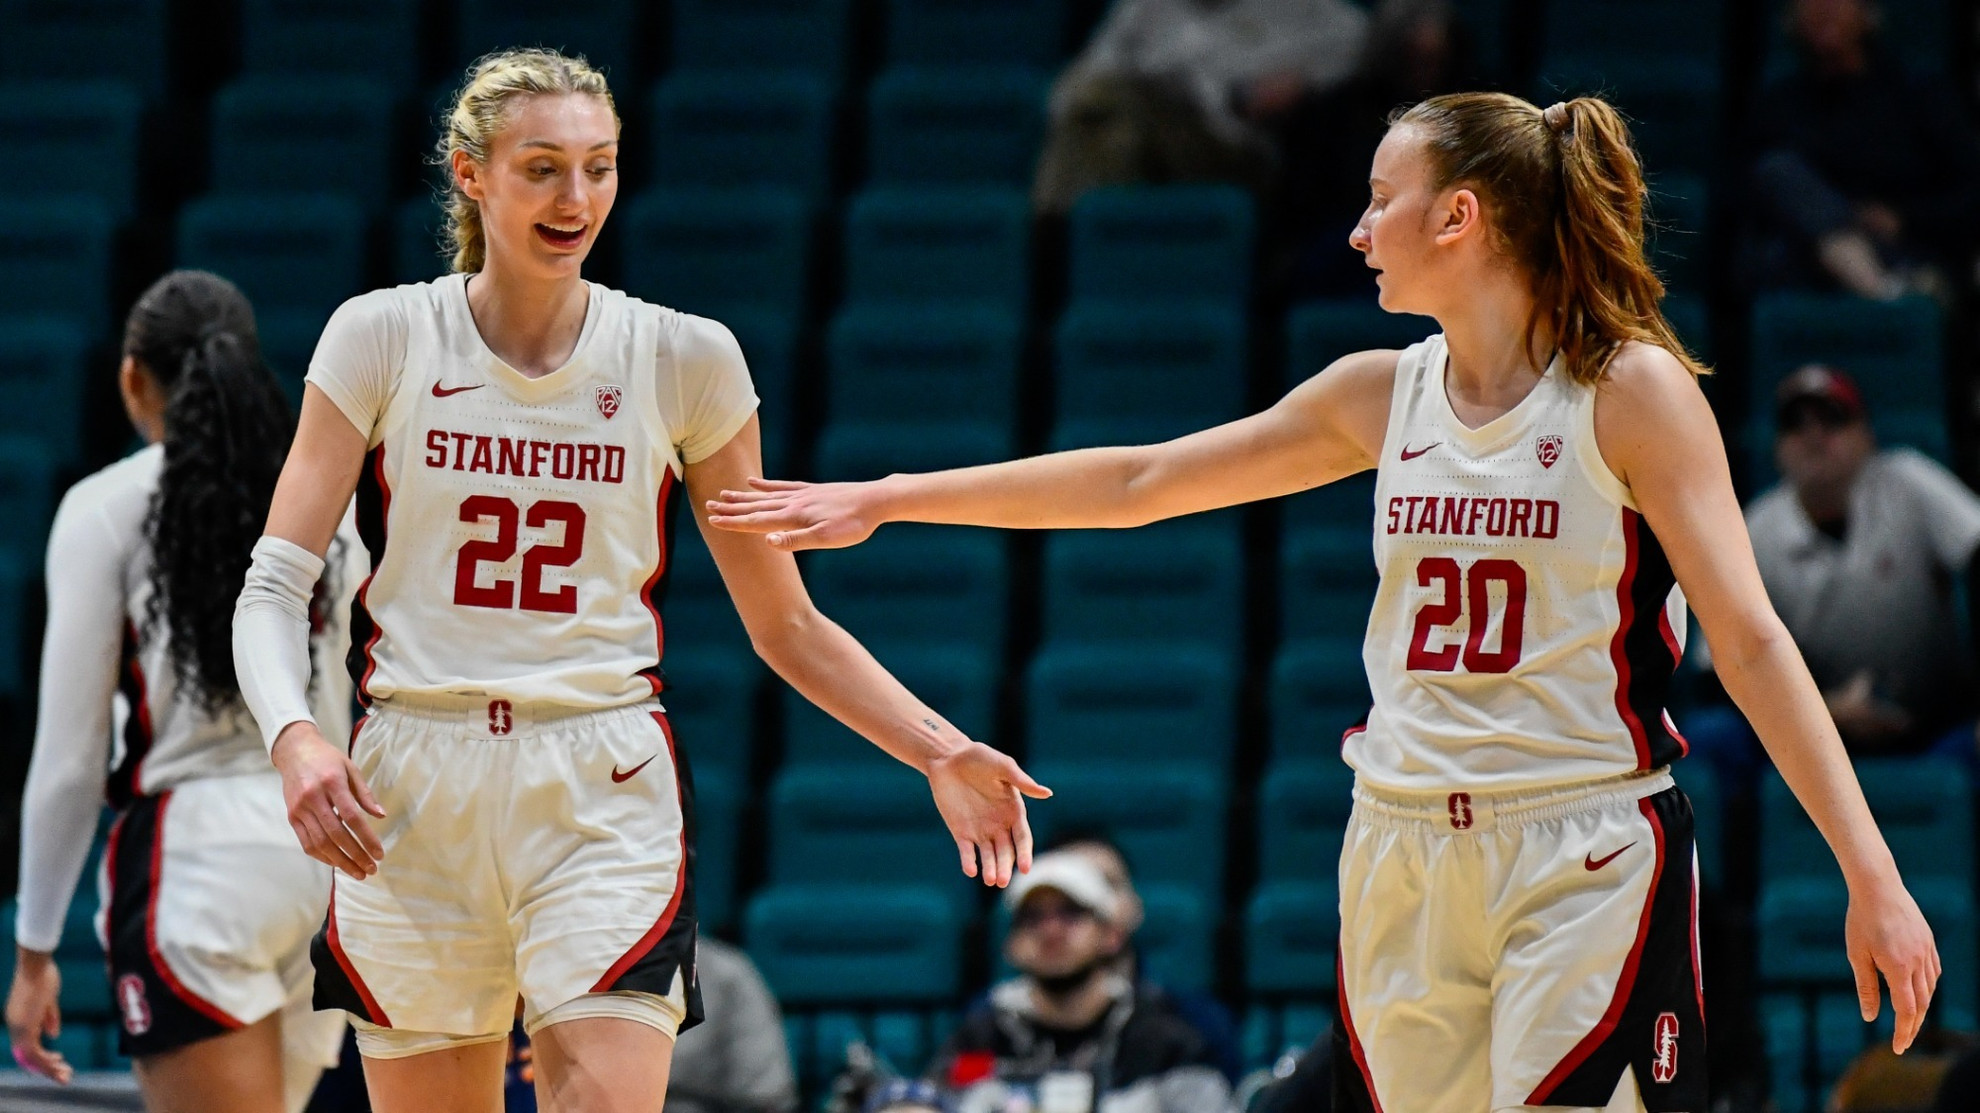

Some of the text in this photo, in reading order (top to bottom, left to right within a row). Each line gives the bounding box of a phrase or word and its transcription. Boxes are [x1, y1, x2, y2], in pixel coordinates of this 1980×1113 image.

[597, 385, 621, 406] PAC
[602, 400, 615, 413] 12
[426, 429, 626, 484] STANFORD
[1537, 435, 1562, 455] PAC
[1541, 449, 1555, 462] 12
[1387, 496, 1560, 540] STANFORD
[454, 494, 587, 614] 22
[1406, 557, 1527, 674] 20
